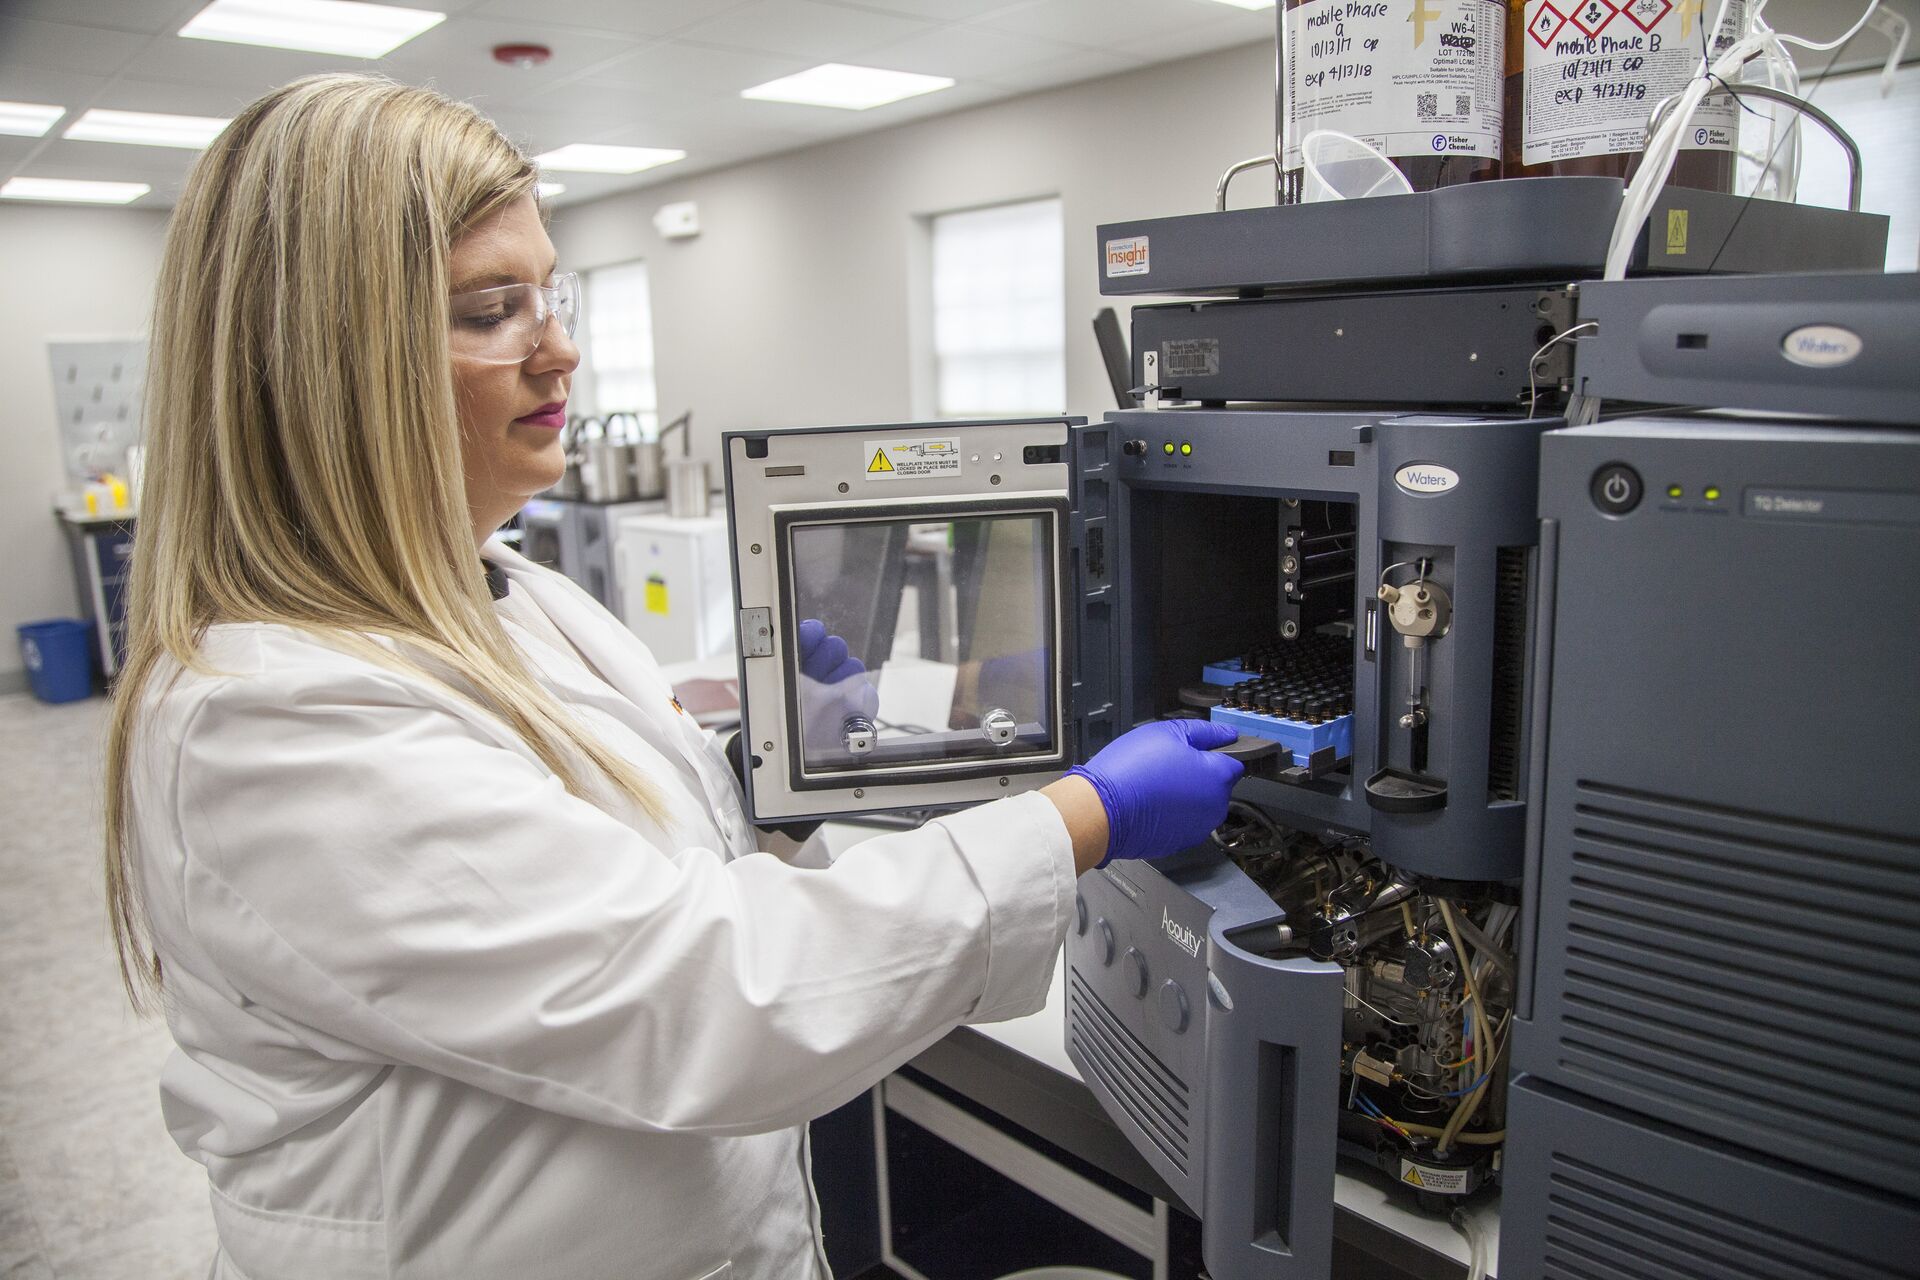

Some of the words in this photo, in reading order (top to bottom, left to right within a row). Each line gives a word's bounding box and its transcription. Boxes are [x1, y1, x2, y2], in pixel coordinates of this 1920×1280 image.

[1308, 6, 1343, 30] mobile
[1346, 1, 1388, 18] Phase
[1464, 13, 1469, 21] 4
[1471, 14, 1476, 22] L
[1451, 22, 1476, 34] W6-4
[1310, 38, 1352, 58] 10/13/17
[1601, 36, 1642, 53] Phase
[1650, 34, 1662, 52] B
[1304, 71, 1325, 87] exp
[1328, 64, 1372, 81] 4/13/18
[1555, 89, 1583, 105] exp
[1709, 129, 1726, 137] Fisher
[1709, 138, 1730, 146] Chemical
[1108, 241, 1146, 267] Insight
[1407, 471, 1447, 486] Waters
